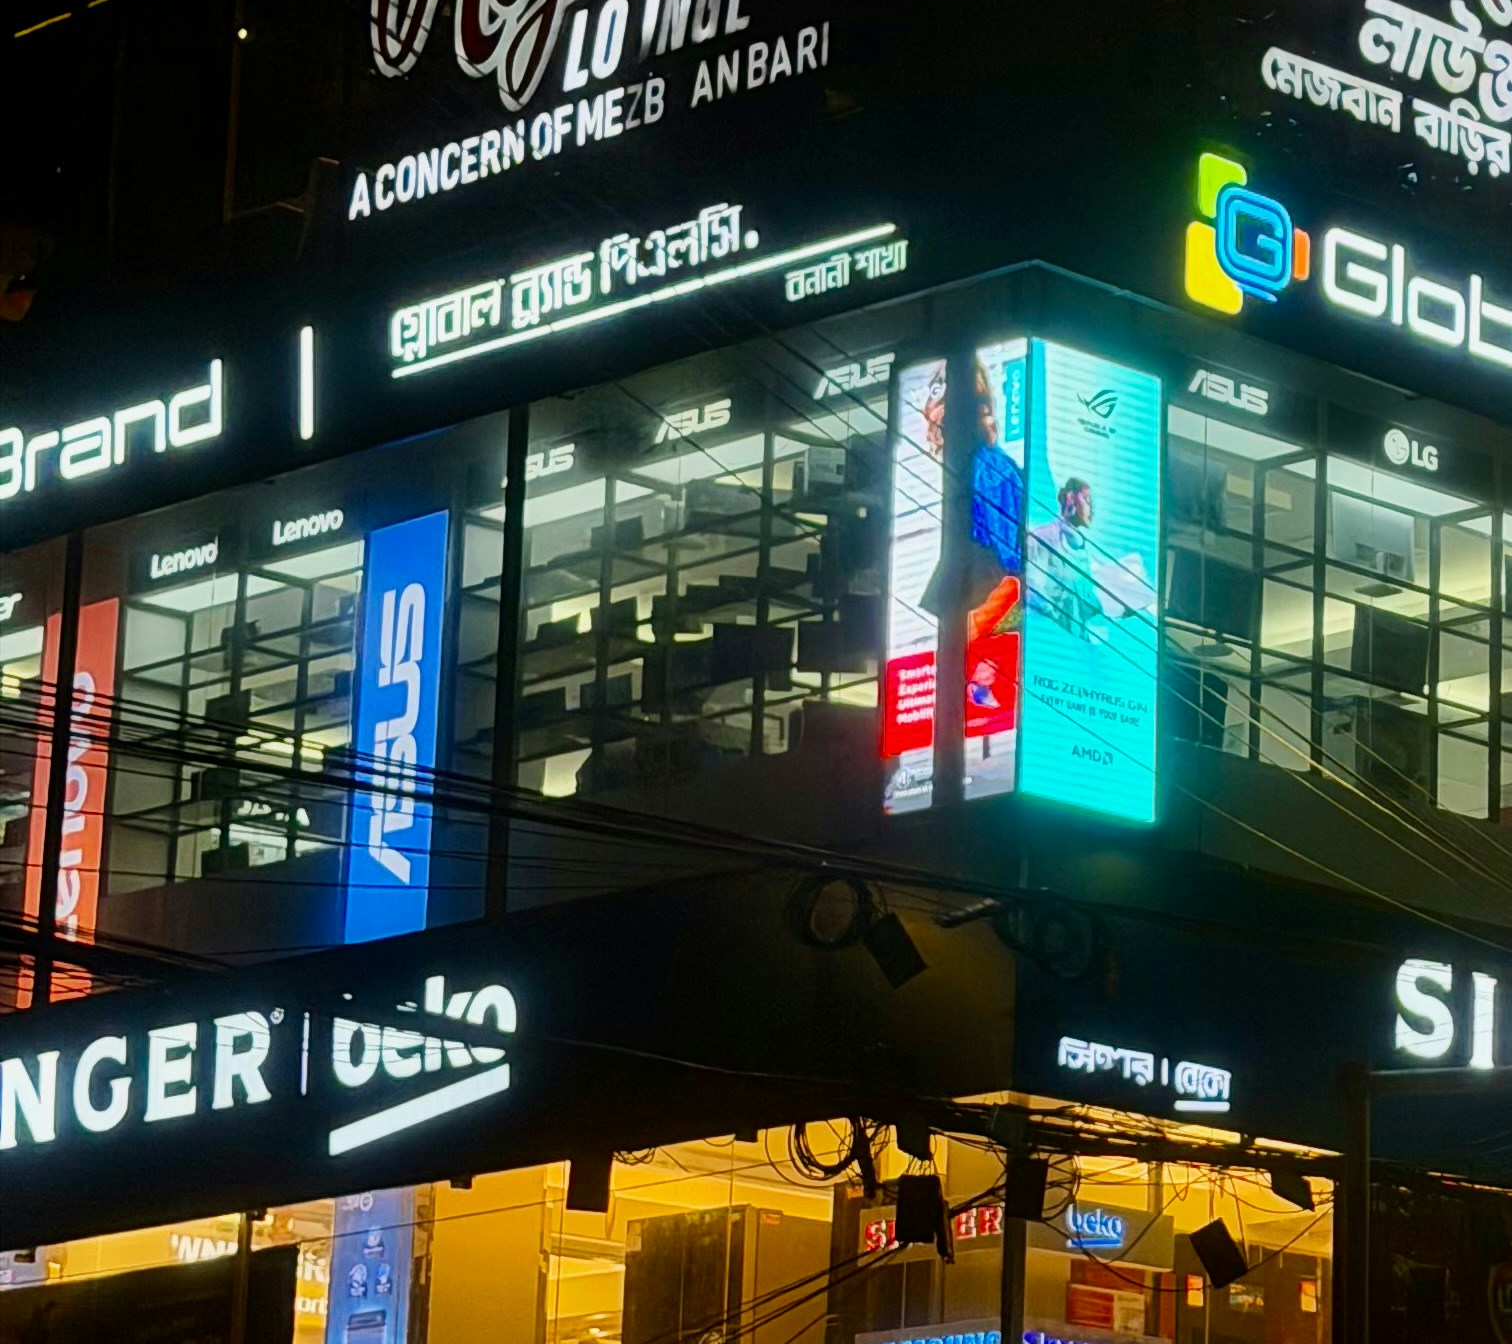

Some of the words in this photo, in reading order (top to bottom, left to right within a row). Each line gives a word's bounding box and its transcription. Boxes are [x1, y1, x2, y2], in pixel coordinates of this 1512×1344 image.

[1261, 47, 1403, 133] মেজবান
[1412, 99, 1511, 175] বাড়ির
[348, 172, 370, 221] A
[375, 119, 525, 210] CONCERN
[531, 104, 578, 156] OF
[785, 255, 853, 302] বনানী
[855, 239, 909, 280] শাখা
[390, 278, 506, 362] গ্লোবাল
[813, 352, 896, 400] ASUS
[1187, 369, 1269, 417] ASUS
[655, 398, 733, 444] ASUS
[526, 443, 576, 482] SUS
[1411, 447, 1439, 472] LG
[273, 509, 344, 546] Lenovo
[151, 537, 219, 579] Lenovo
[368, 581, 426, 886] ASUS
[1072, 745, 1101, 762] AMD
[864, 1201, 1006, 1252] SIER
[1067, 1203, 1125, 1241] beko
